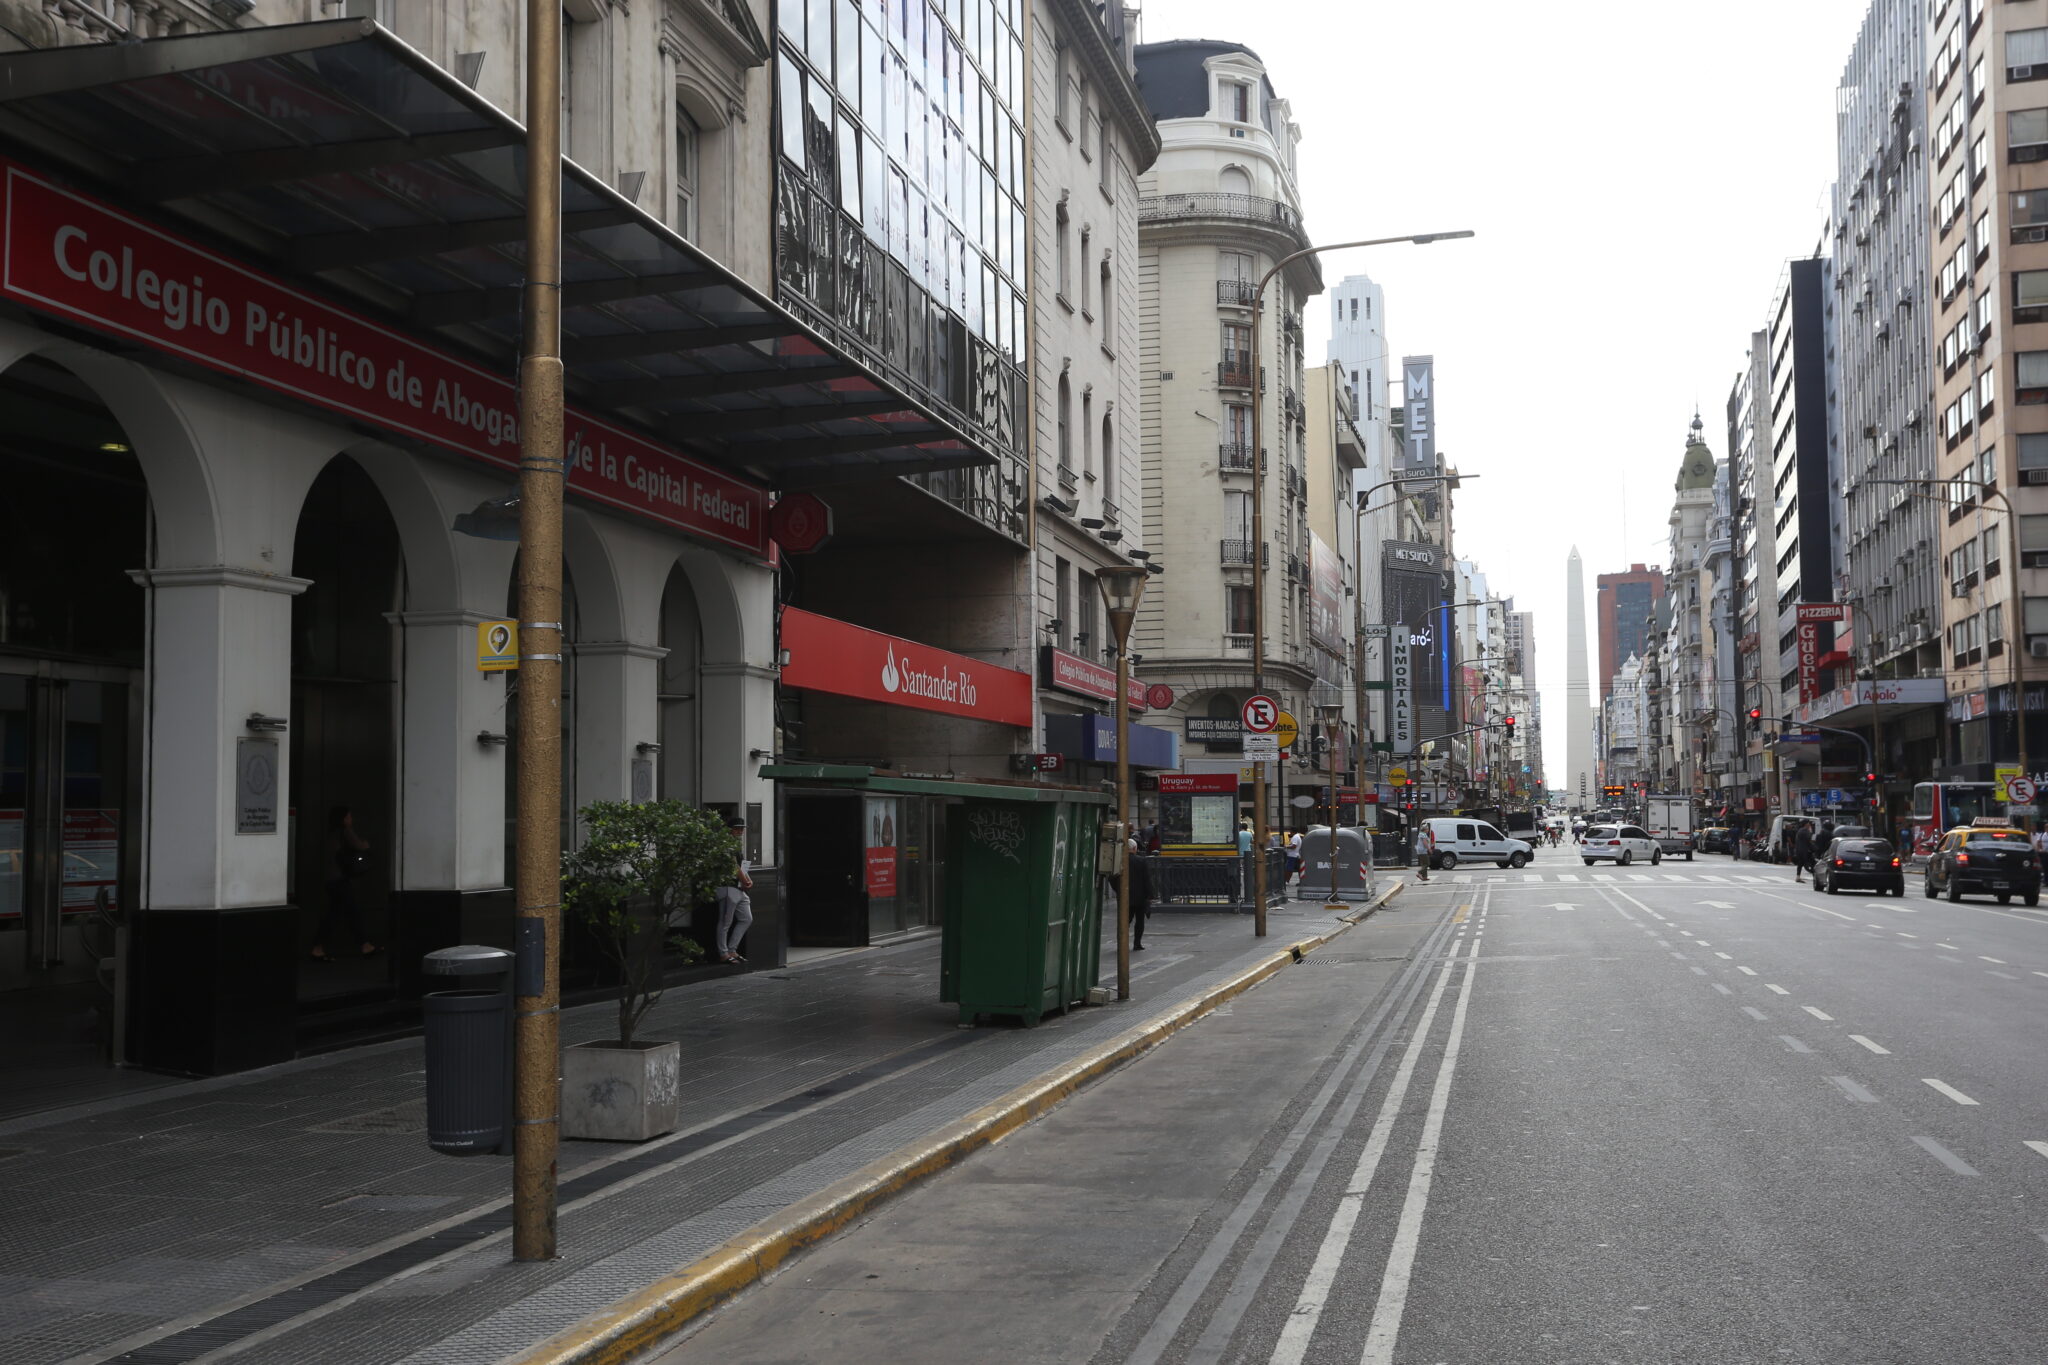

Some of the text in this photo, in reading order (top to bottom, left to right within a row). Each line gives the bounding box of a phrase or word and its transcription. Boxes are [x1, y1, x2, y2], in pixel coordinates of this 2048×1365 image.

[54, 225, 750, 531] Colegio Público de Aboga de la Capital Federal
[1407, 368, 1429, 462] MET
[1799, 606, 1842, 618] PIZZERIA
[1410, 634, 1428, 646] aro
[1799, 623, 1816, 701] Güerri
[901, 657, 977, 707] Santander Río
[1394, 634, 1408, 741] INMORTALES
[1270, 723, 1293, 732] ubte
[1162, 777, 1194, 786] Uruguay
[1810, 793, 1817, 801] E
[1831, 789, 1838, 798] E
